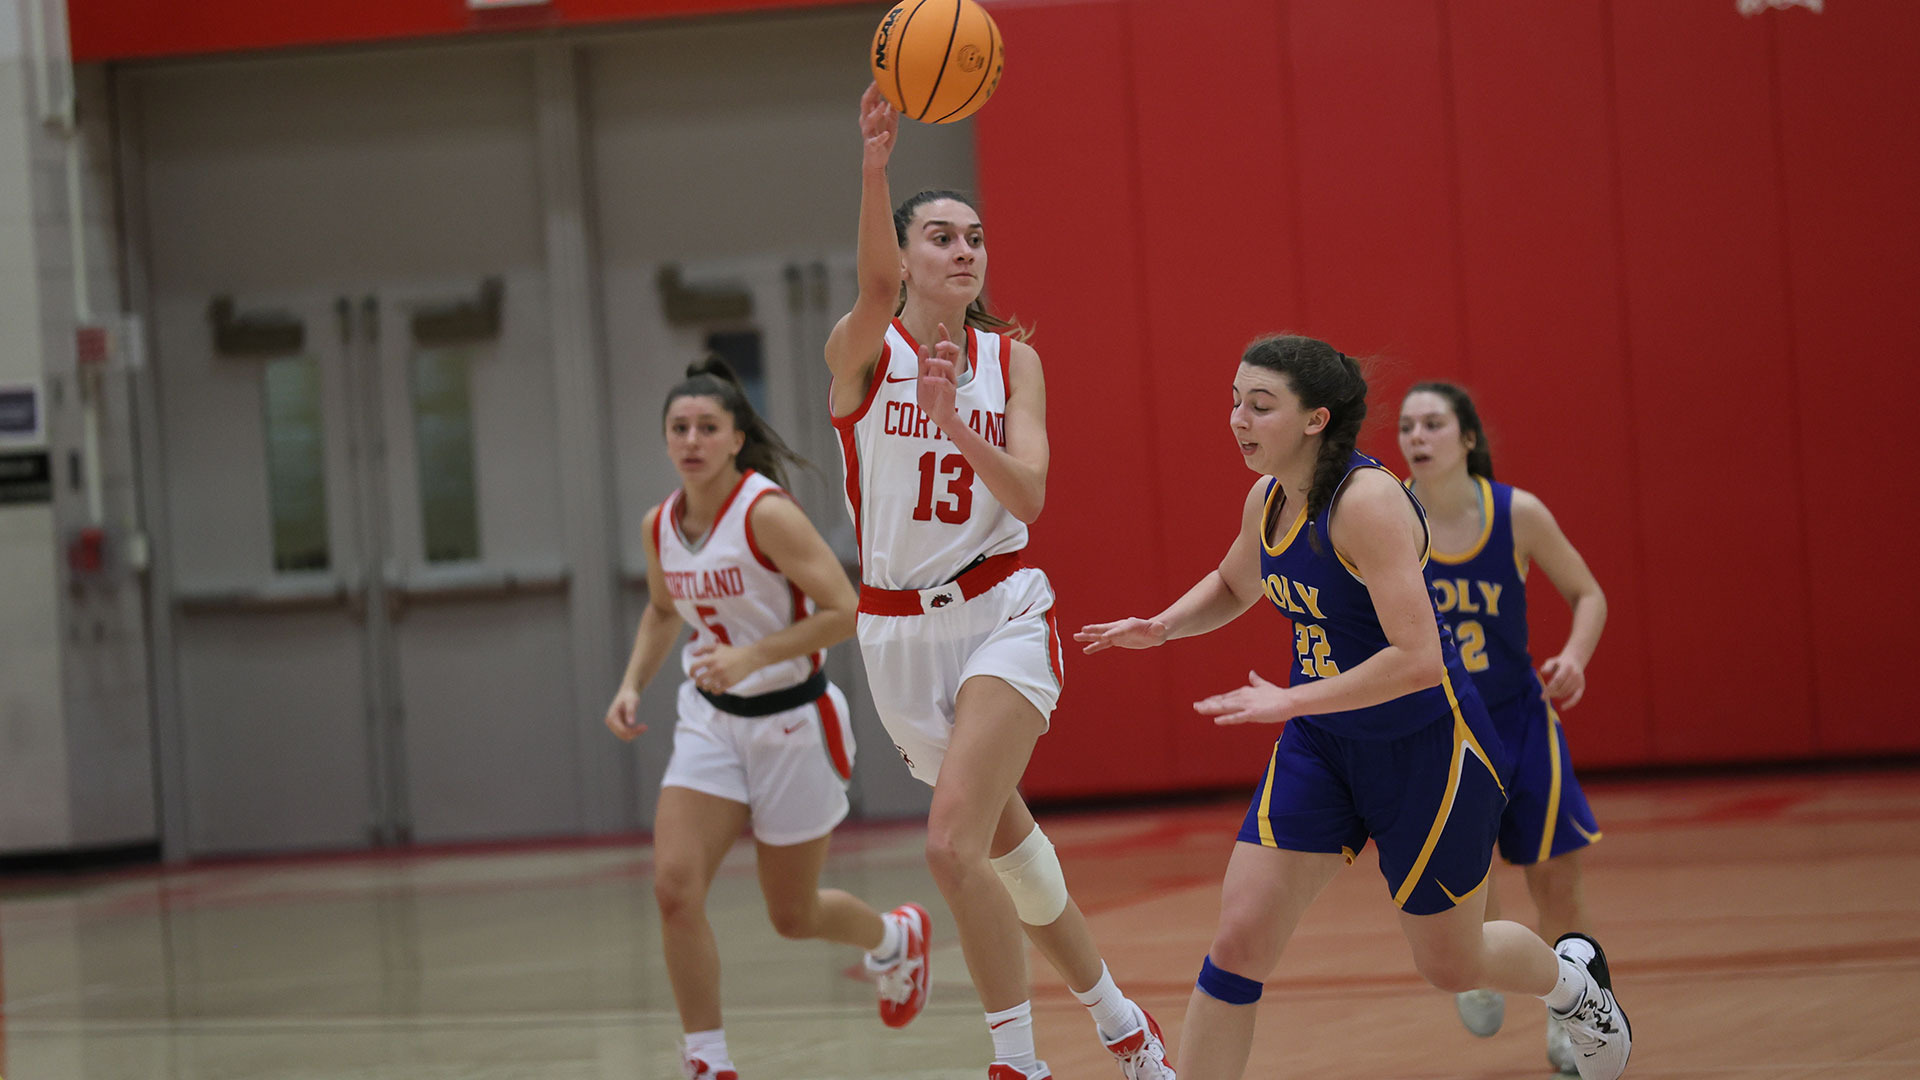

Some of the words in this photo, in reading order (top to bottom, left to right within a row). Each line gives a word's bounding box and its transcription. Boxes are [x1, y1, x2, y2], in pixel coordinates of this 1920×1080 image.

[876, 8, 903, 70] NCAA
[912, 451, 975, 525] 13
[1295, 623, 1341, 678] 22
